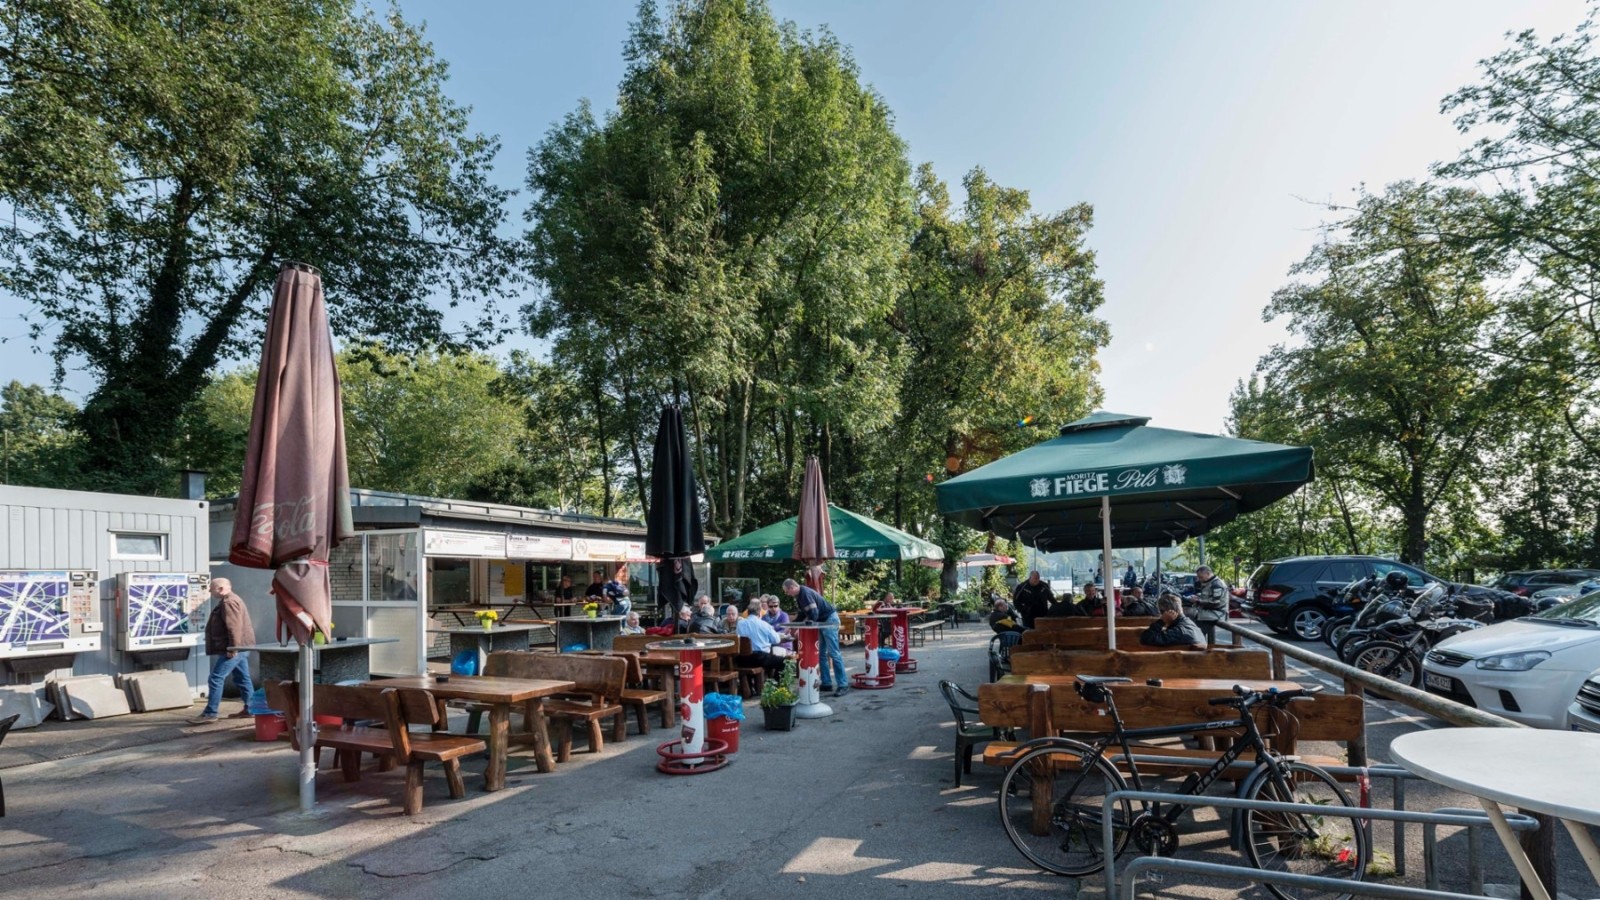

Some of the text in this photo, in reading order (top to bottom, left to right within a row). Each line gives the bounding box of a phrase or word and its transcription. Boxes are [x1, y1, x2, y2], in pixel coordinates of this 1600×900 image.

[1054, 468, 1160, 496] FIEGE Pils
[1066, 472, 1096, 480] MORITZ
